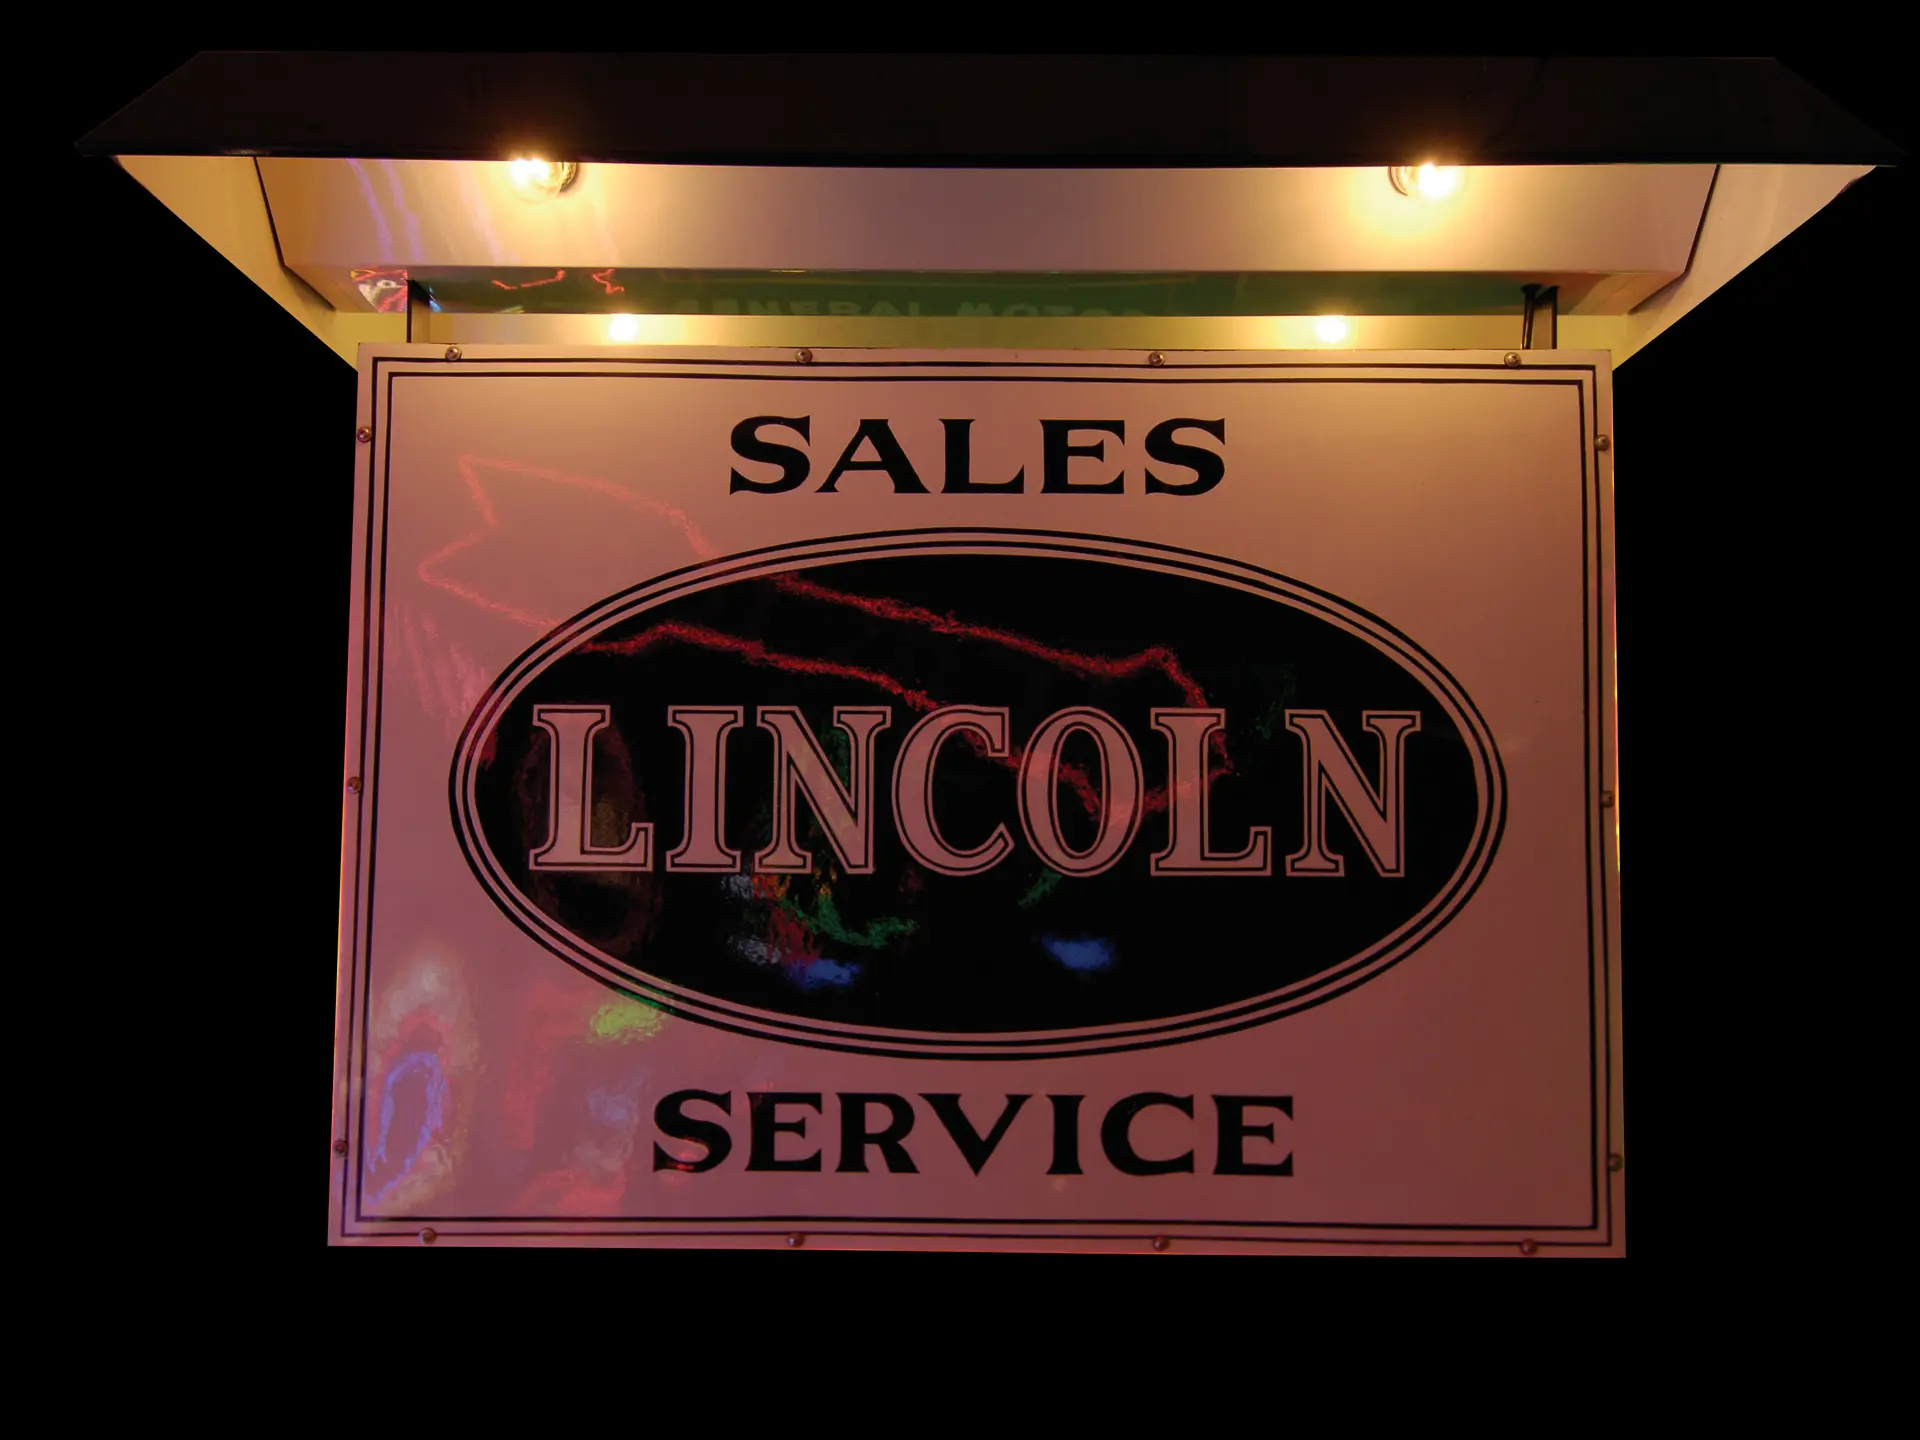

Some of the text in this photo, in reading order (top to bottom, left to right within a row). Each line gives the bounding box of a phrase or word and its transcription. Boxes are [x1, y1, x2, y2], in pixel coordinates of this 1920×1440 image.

[729, 414, 1225, 496] SALES
[529, 704, 1421, 877] LINCOLN
[653, 1089, 1294, 1177] SERVICE
